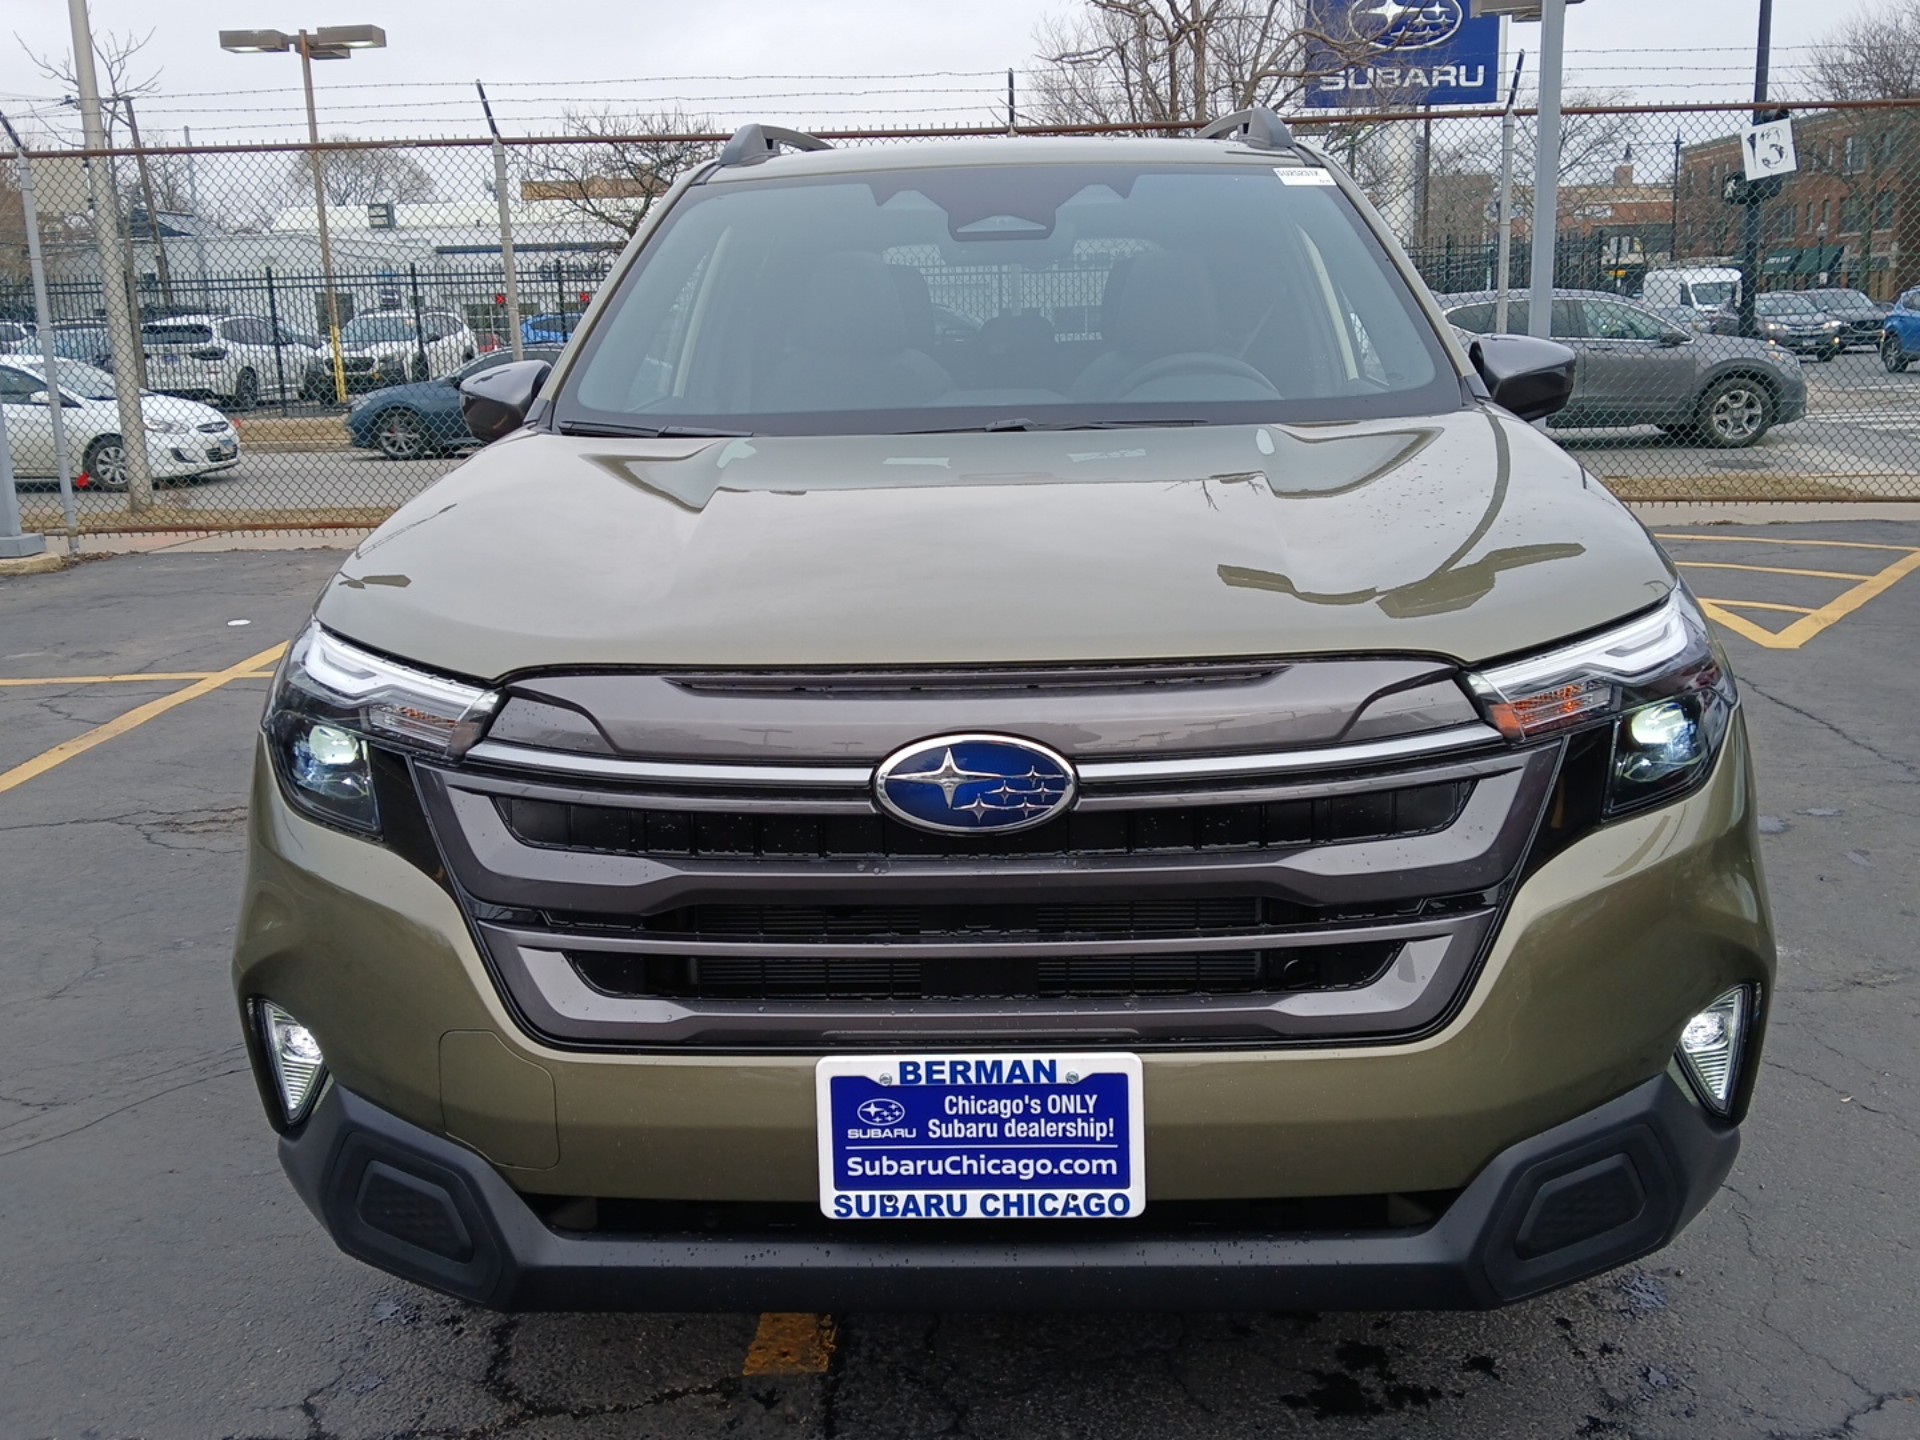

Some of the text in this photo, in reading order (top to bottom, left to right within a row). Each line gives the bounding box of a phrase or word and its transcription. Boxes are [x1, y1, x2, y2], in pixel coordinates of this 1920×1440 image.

[1320, 65, 1485, 92] SUBARU
[899, 1059, 1057, 1085] BERMAN
[944, 1094, 1098, 1118] Chicago's ONLY
[847, 1127, 916, 1139] SUBARU
[928, 1118, 1114, 1141] Subaru dealership!
[847, 1154, 1118, 1180] SubaruChicago.com
[834, 1192, 1130, 1219] SUBARU CHICAGO
